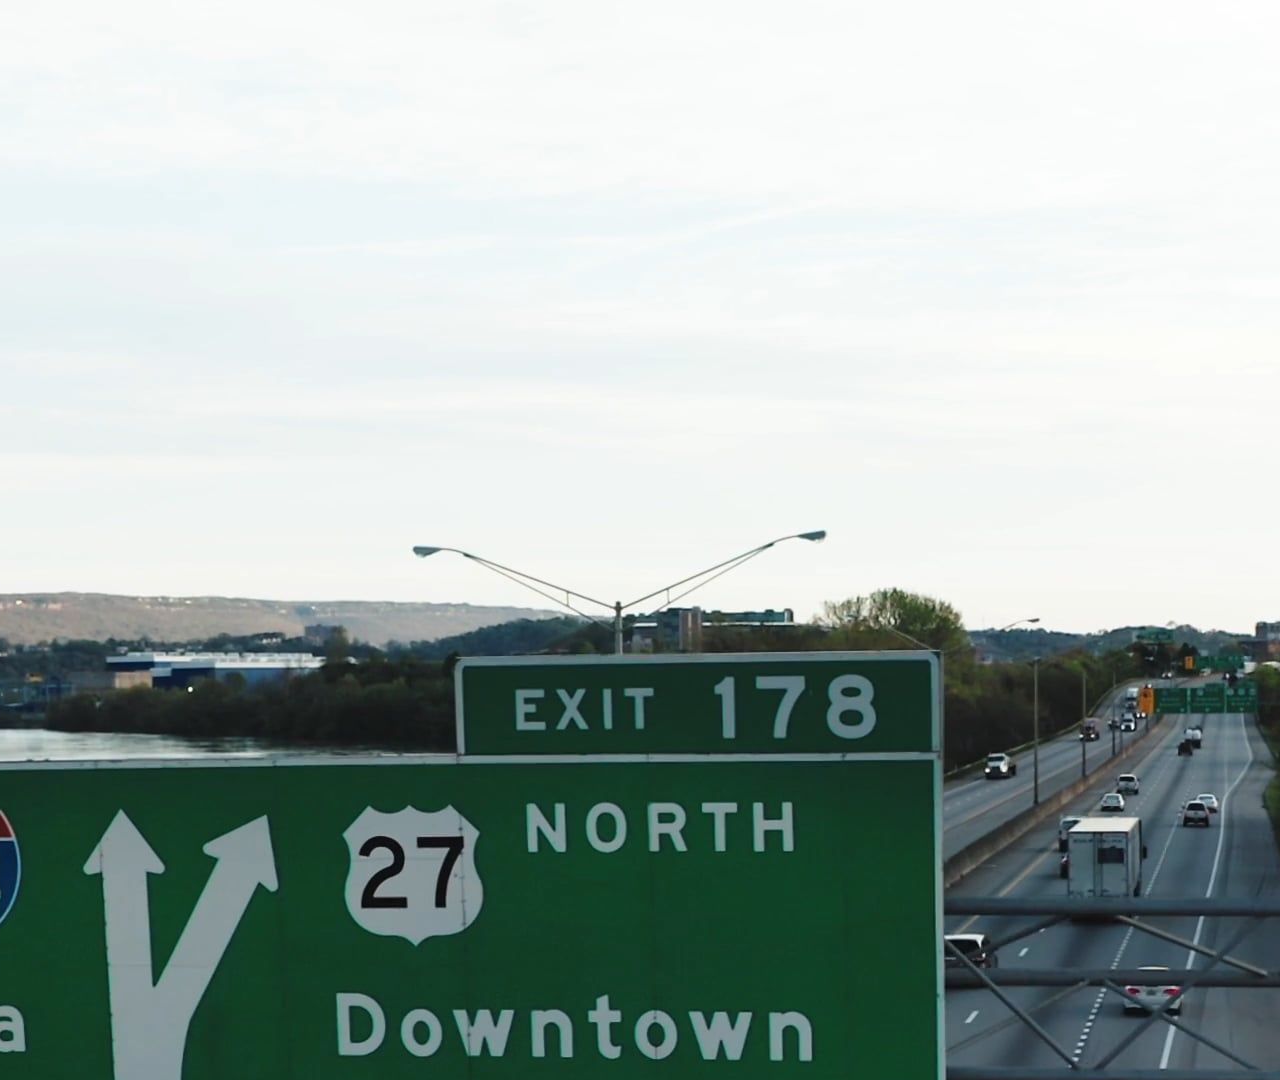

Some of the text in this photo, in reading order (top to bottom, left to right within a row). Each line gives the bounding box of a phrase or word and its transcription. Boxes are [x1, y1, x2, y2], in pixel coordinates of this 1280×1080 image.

[516, 674, 877, 740] EXIT 178
[526, 802, 795, 853] NORTH
[358, 836, 465, 909] 27
[335, 992, 814, 1062] Downtown
